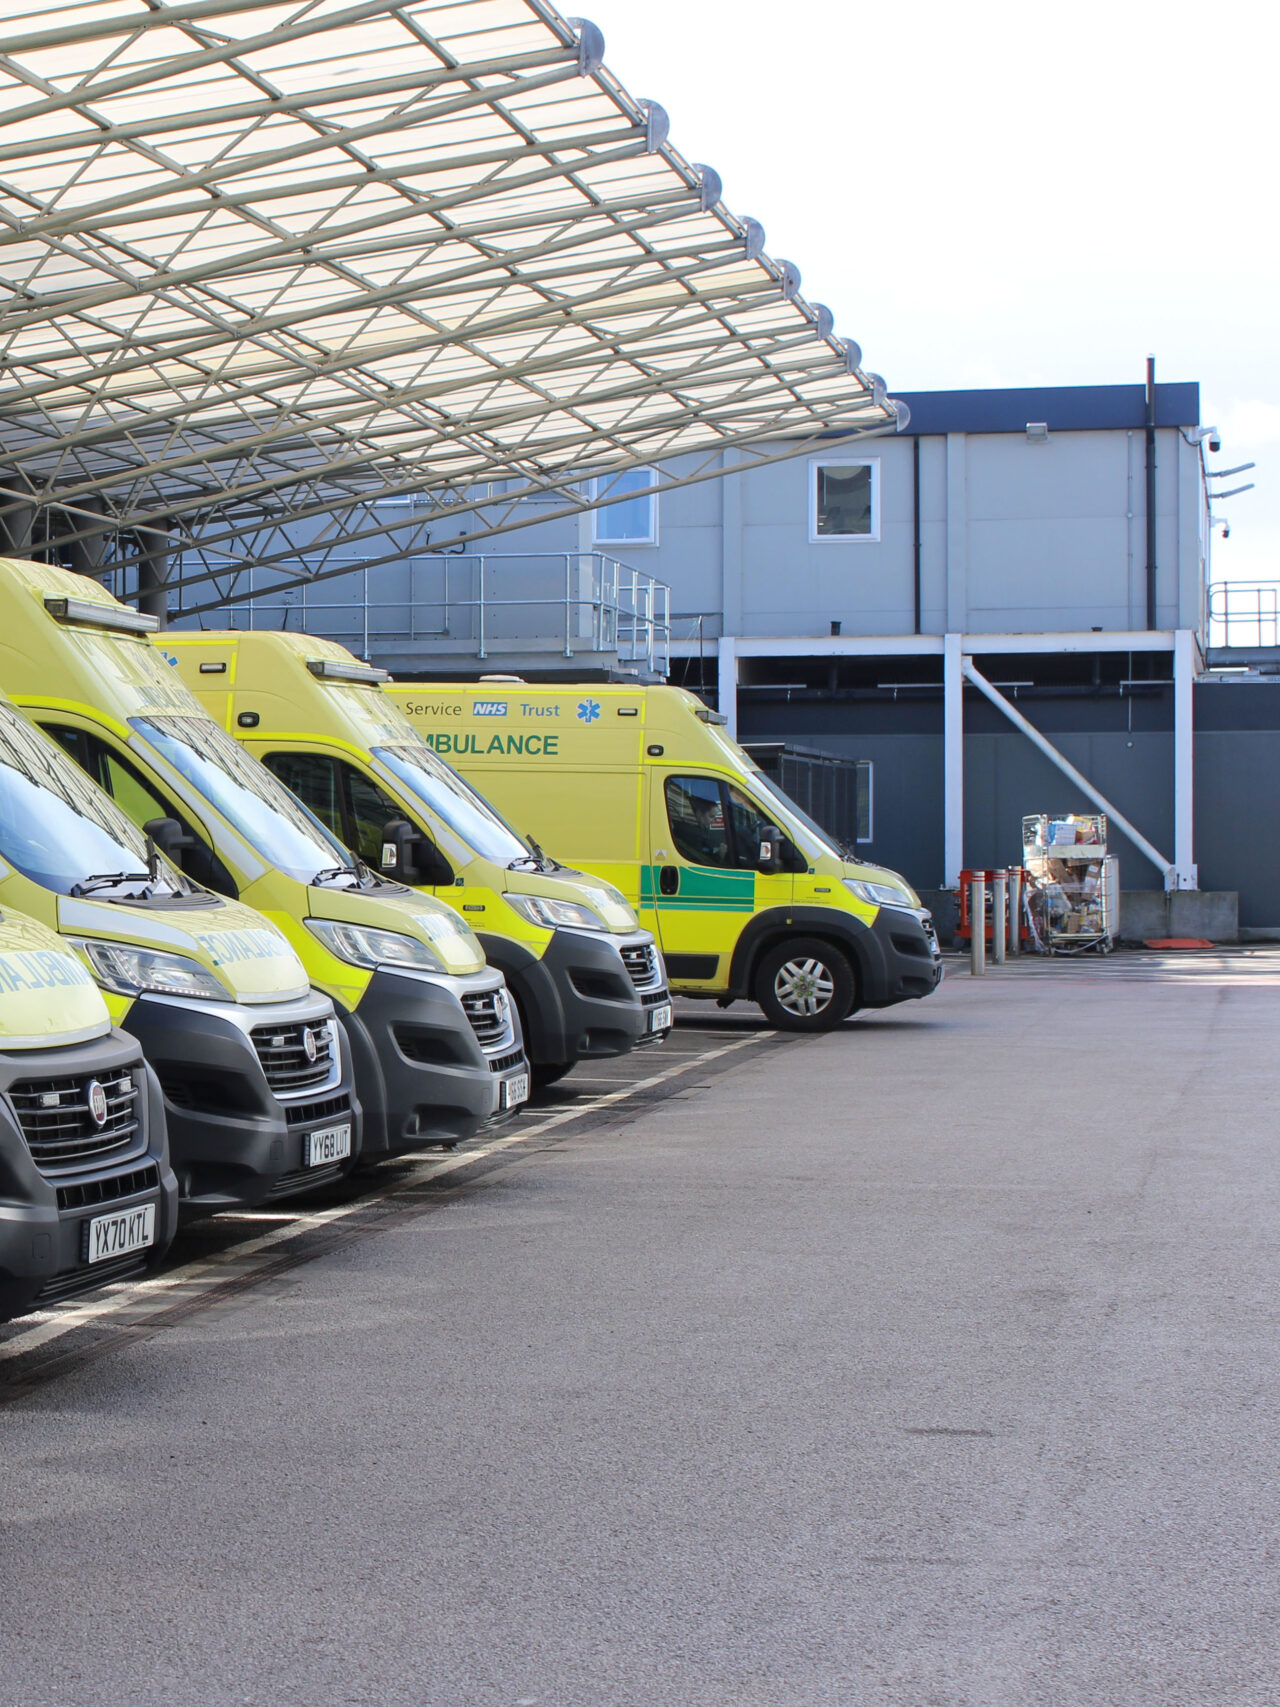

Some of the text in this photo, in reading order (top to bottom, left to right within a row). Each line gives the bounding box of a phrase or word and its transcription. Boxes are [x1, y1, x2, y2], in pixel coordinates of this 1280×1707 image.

[406, 701, 462, 716] Service
[473, 702, 507, 716] NHS
[520, 703, 561, 717] Trust
[425, 733, 559, 755] BULANCE
[313, 1133, 335, 1161] YY68
[95, 1211, 149, 1256] YX70 KTL
